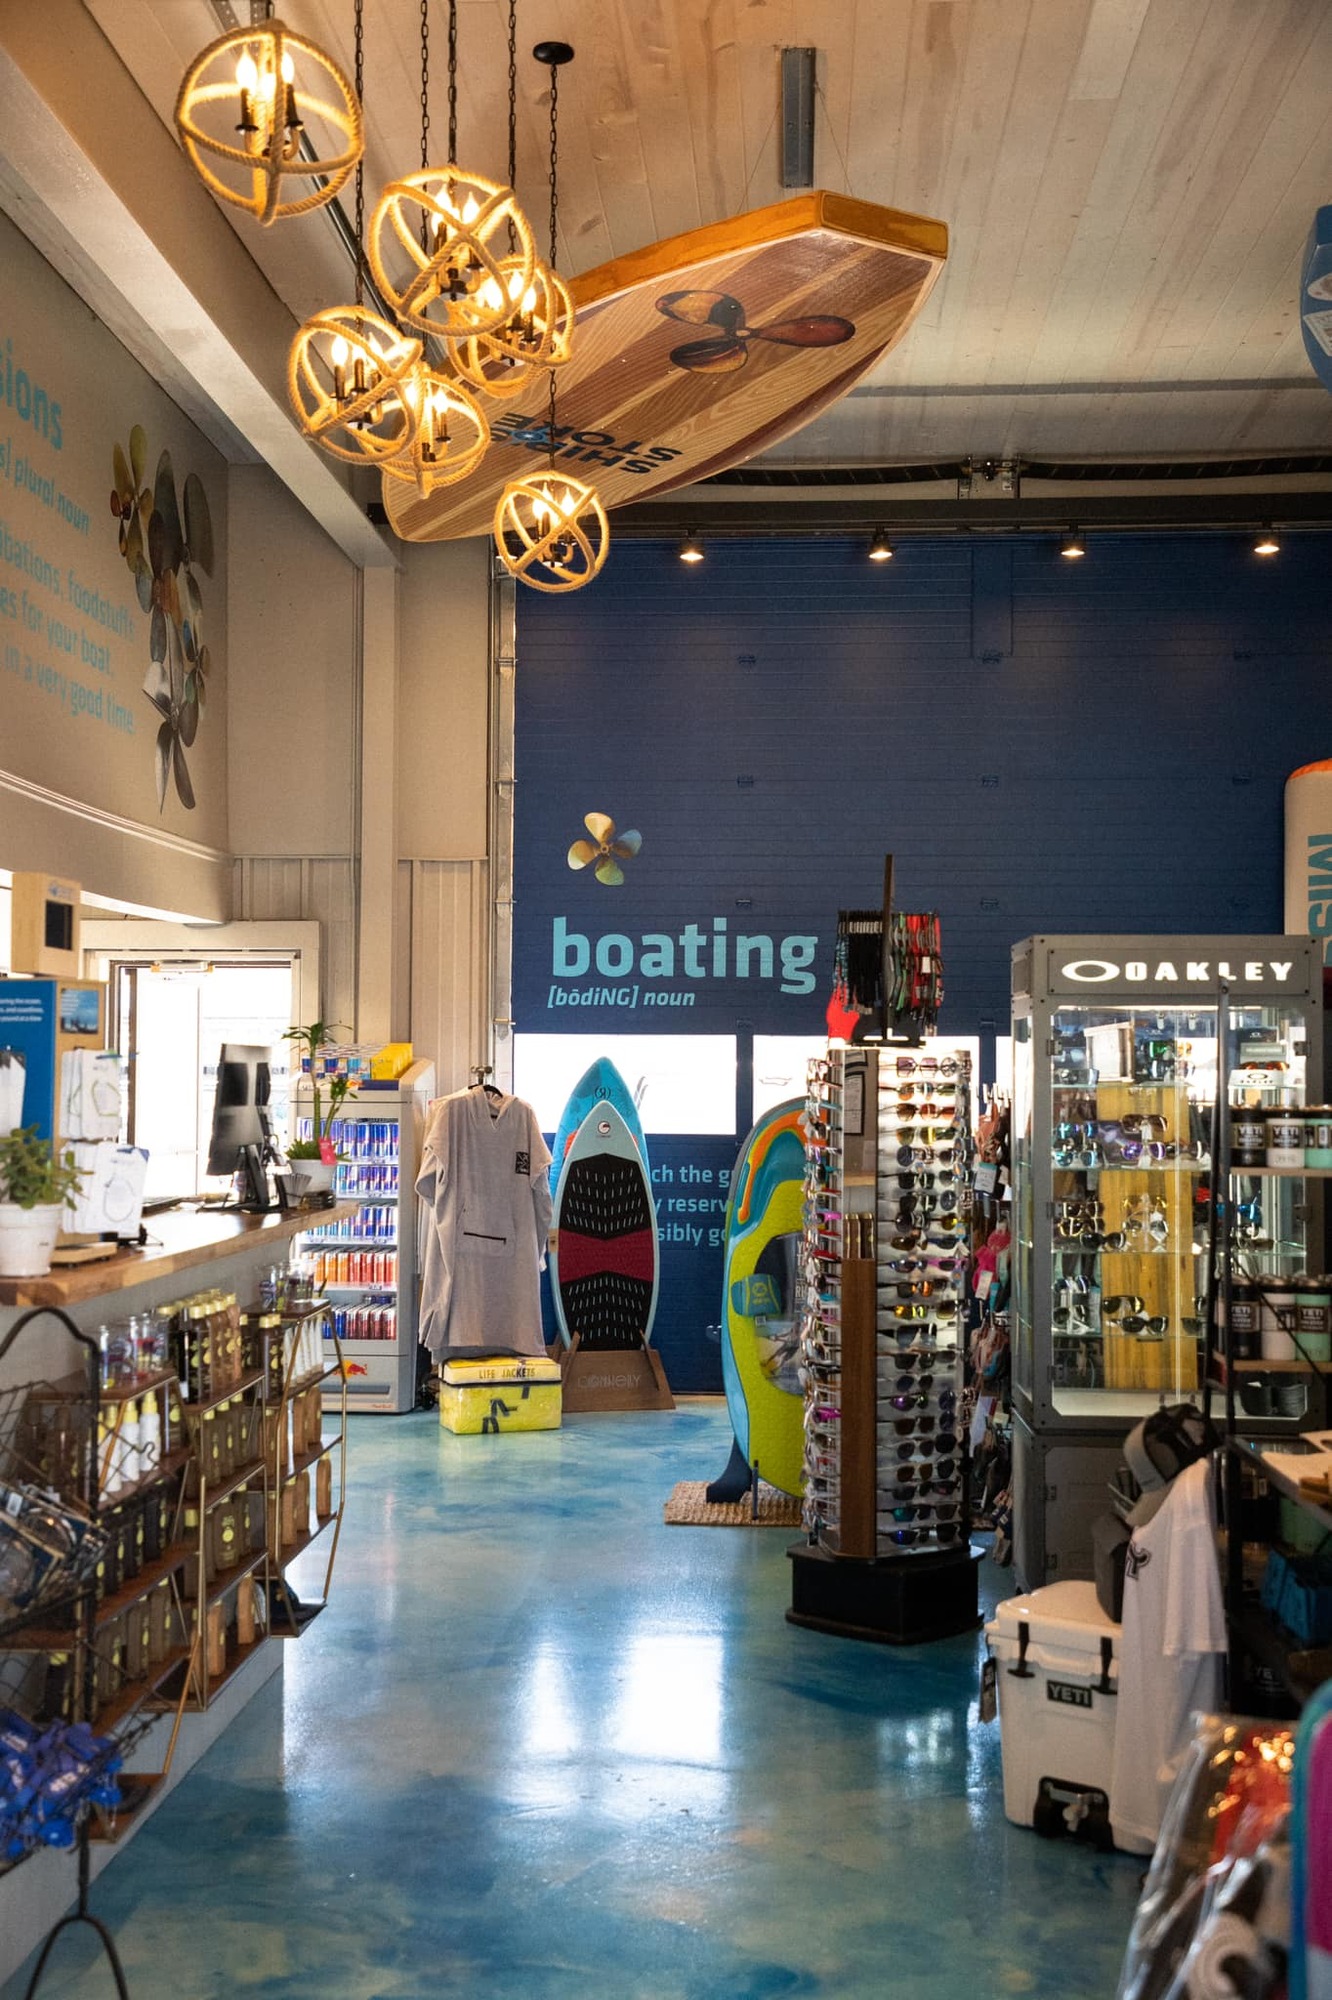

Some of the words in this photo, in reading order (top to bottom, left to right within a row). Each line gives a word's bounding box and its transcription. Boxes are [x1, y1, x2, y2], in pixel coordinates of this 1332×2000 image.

[15, 457, 54, 508] plural
[57, 491, 90, 537] noun
[68, 567, 135, 645] foodstuffs
[22, 588, 43, 634] for
[47, 617, 78, 656] your
[37, 664, 67, 706] very
[70, 680, 103, 719] good
[552, 916, 818, 995] boating
[1125, 961, 1294, 982] OAKLEY
[644, 991, 695, 1007] noun
[1273, 1126, 1299, 1135] YETI
[679, 1164, 713, 1183] the
[479, 1369, 495, 1379] LIFE
[501, 1367, 536, 1379] JACKETS
[1049, 1685, 1090, 1706] YETI
